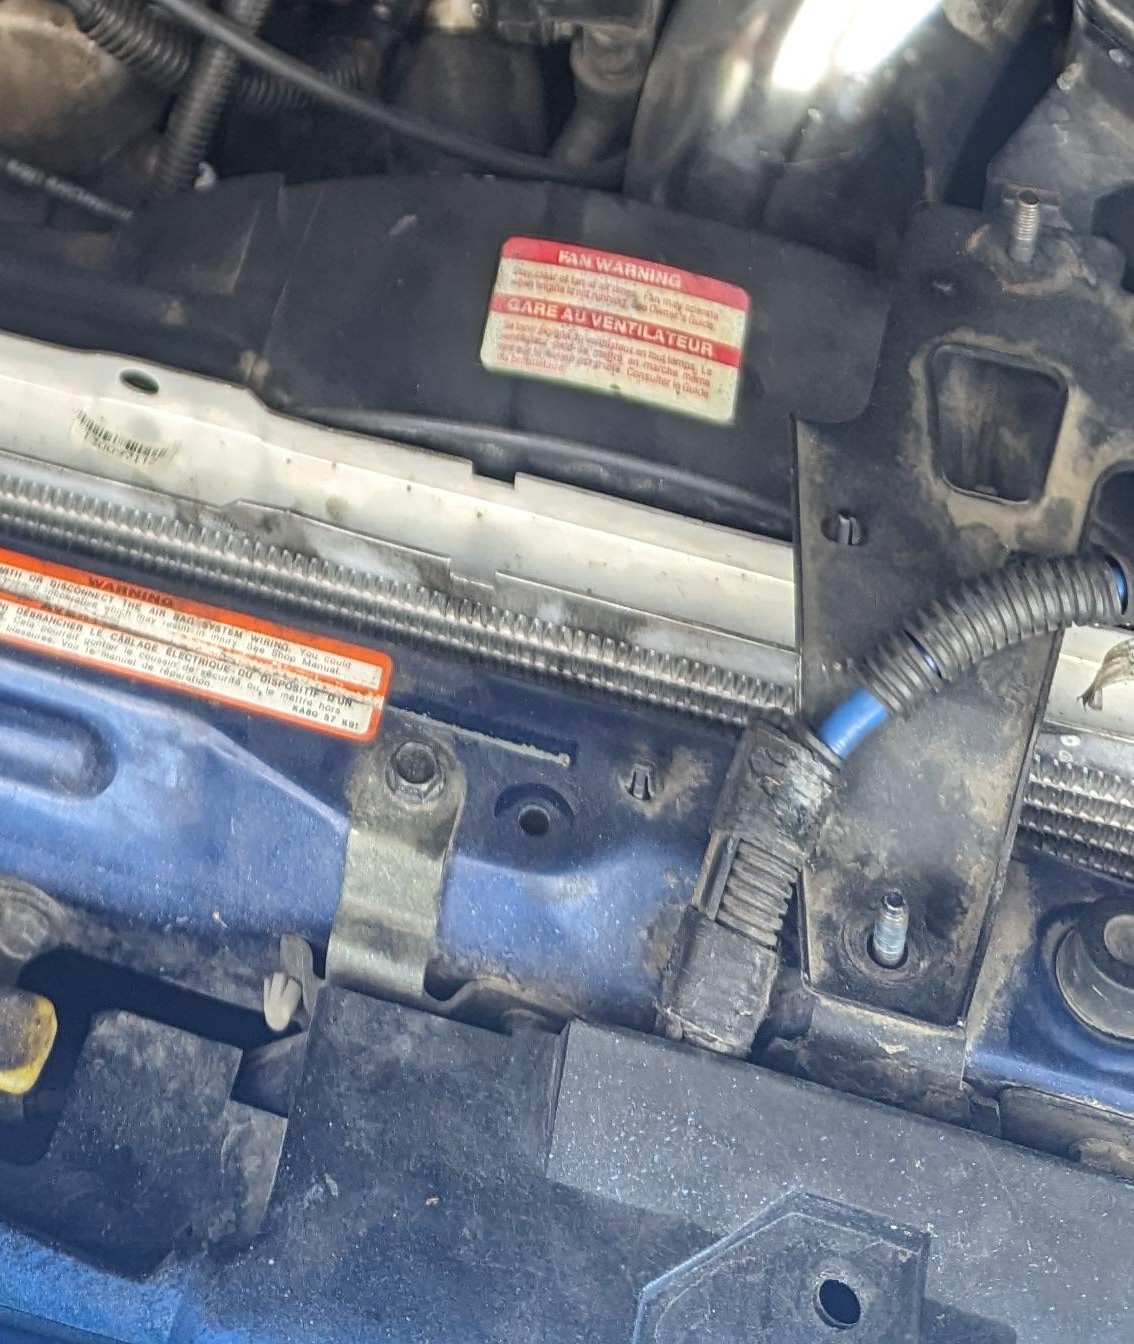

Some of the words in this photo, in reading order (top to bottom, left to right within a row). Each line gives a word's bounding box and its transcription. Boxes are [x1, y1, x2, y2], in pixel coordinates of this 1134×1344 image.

[559, 249, 593, 269] FAN
[596, 255, 683, 289] WARNING
[506, 298, 558, 319] GARE
[560, 308, 588, 325] AU
[591, 313, 714, 358] VENTILATEUR
[86, 575, 175, 609] WARNING
[27, 572, 44, 585] OR
[48, 578, 115, 604] DISCONNECT
[122, 598, 143, 612] THE
[147, 605, 167, 618] AIR
[171, 612, 196, 626] BAG
[199, 620, 244, 639] SYSTEM
[297, 647, 319, 660] You
[322, 654, 352, 669] could
[135, 612, 156, 626] may
[269, 648, 296, 665] Shop
[12, 615, 35, 628] Cela
[181, 662, 196, 673] de
[199, 667, 242, 687] sécurité
[245, 681, 260, 692] ou
[278, 690, 313, 707] mettre
[317, 701, 342, 715] hors
[14, 604, 84, 632] DÉBRANCHER
[88, 626, 103, 637] LE
[108, 629, 159, 653] CÂBLAGE
[164, 645, 232, 673] ÉLECTRIQUE
[236, 667, 253, 680] DU
[258, 673, 320, 698] DISPOSITIF
[100, 649, 137, 667] manuel
